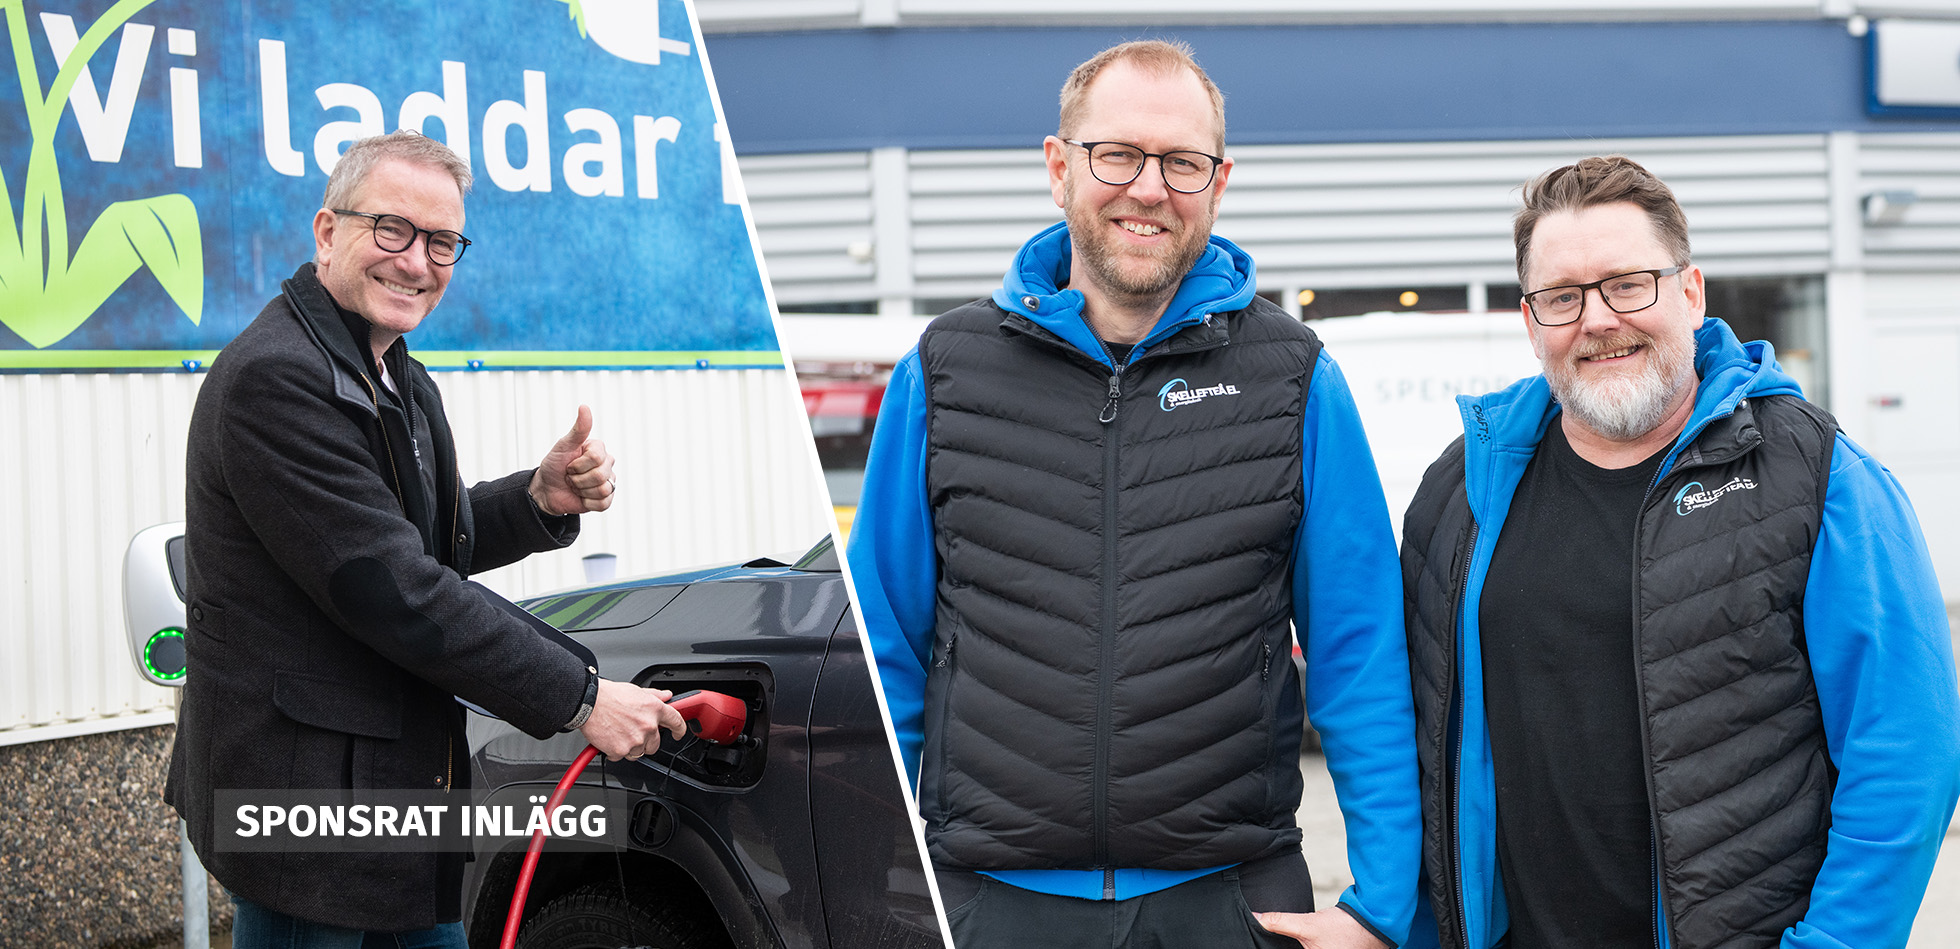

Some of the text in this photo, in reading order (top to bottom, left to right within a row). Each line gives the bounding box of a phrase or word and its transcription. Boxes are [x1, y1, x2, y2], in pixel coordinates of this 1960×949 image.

[40, 12, 203, 169] Vi
[259, 38, 682, 200] laddar
[1167, 383, 1240, 402] SKELLEFTEÅ EL
[1472, 404, 1489, 434] CRAFT
[1682, 477, 1745, 506] SKELLEFTEÅ
